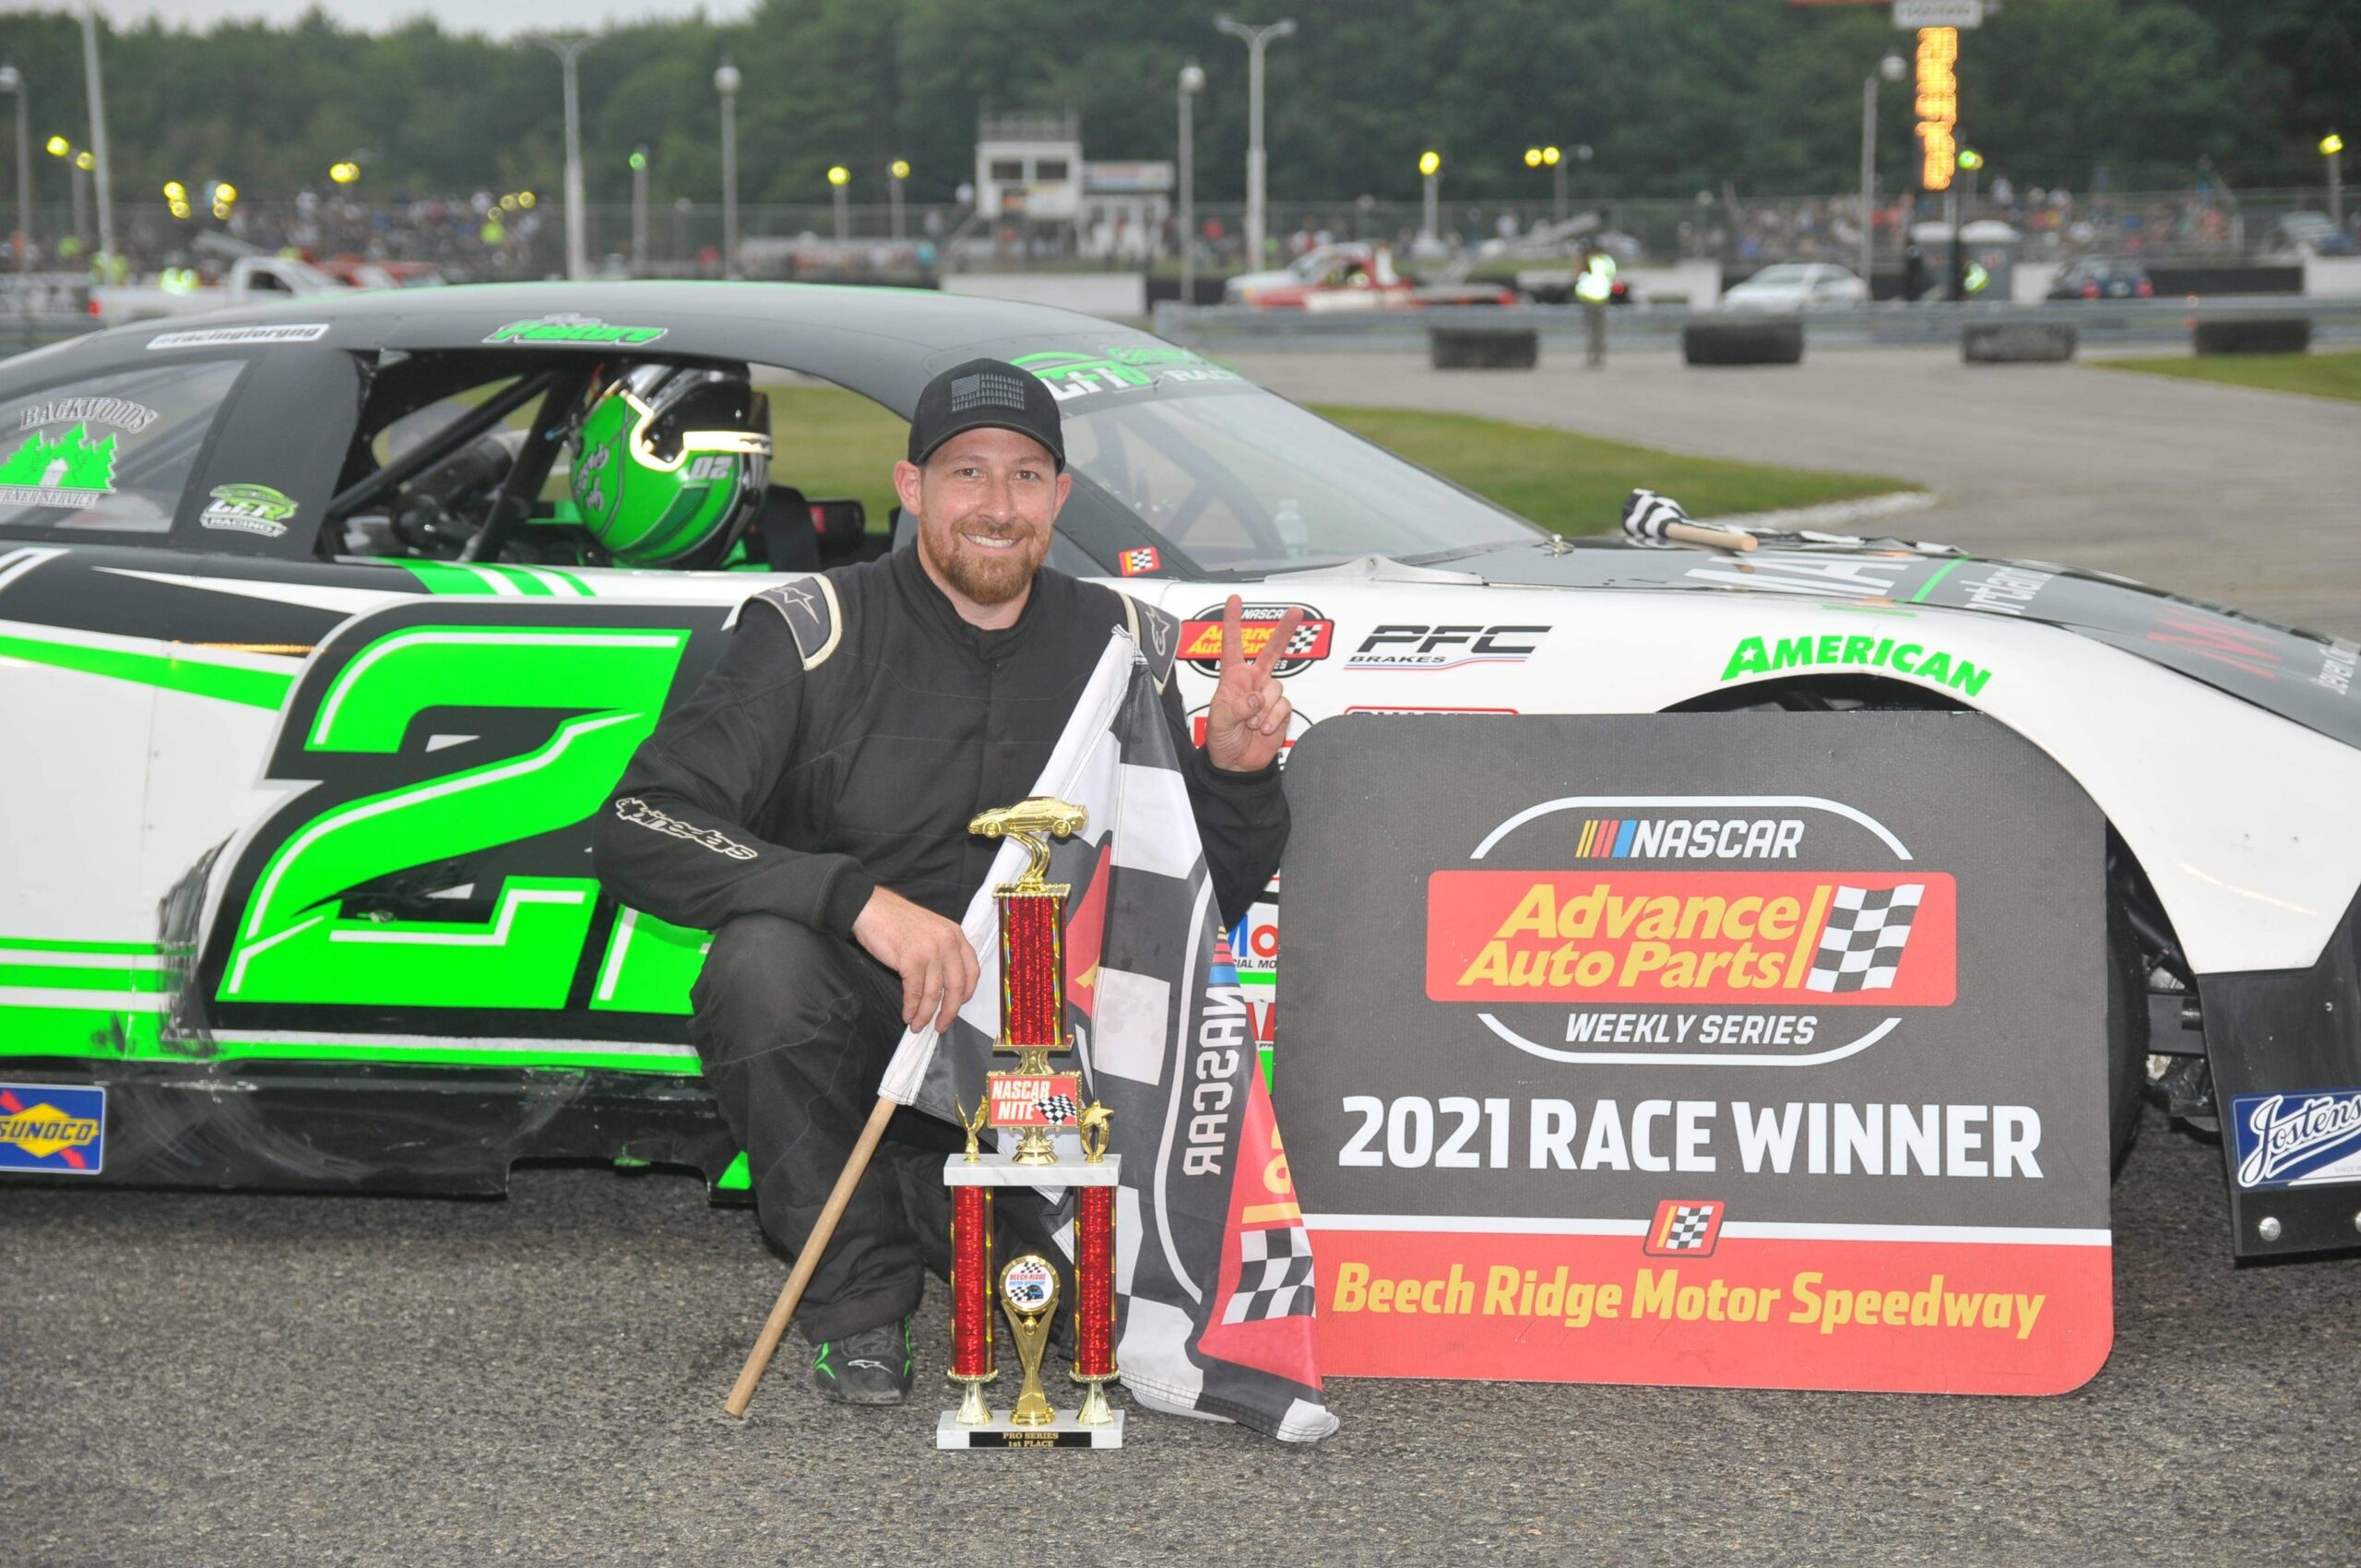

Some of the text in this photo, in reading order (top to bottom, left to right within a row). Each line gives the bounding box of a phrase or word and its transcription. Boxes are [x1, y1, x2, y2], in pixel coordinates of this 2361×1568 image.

[19, 398, 158, 434] BACKWOODS
[689, 457, 734, 480] 02
[1242, 609, 1287, 620] NASCA
[1356, 625, 1554, 654] PFC
[1720, 636, 1992, 697] AMERICAN
[1630, 819, 1806, 859] NASCAR
[1494, 883, 1800, 940] Advance
[1456, 940, 1787, 990] Auto Parts
[1565, 1013, 1819, 1045] WEEKLY SERIES
[991, 1080, 1051, 1100] NASCAR
[997, 1100, 1035, 1121] NITE
[0, 1121, 93, 1141] SUNOCO
[1337, 1095, 1510, 1170] 2021
[1528, 1098, 1718, 1173] RACE
[1731, 1101, 2045, 1180] WINNER
[2241, 1097, 2361, 1185] Jostens
[1331, 1262, 2047, 1340] Beech Ridge Motor Speedway
